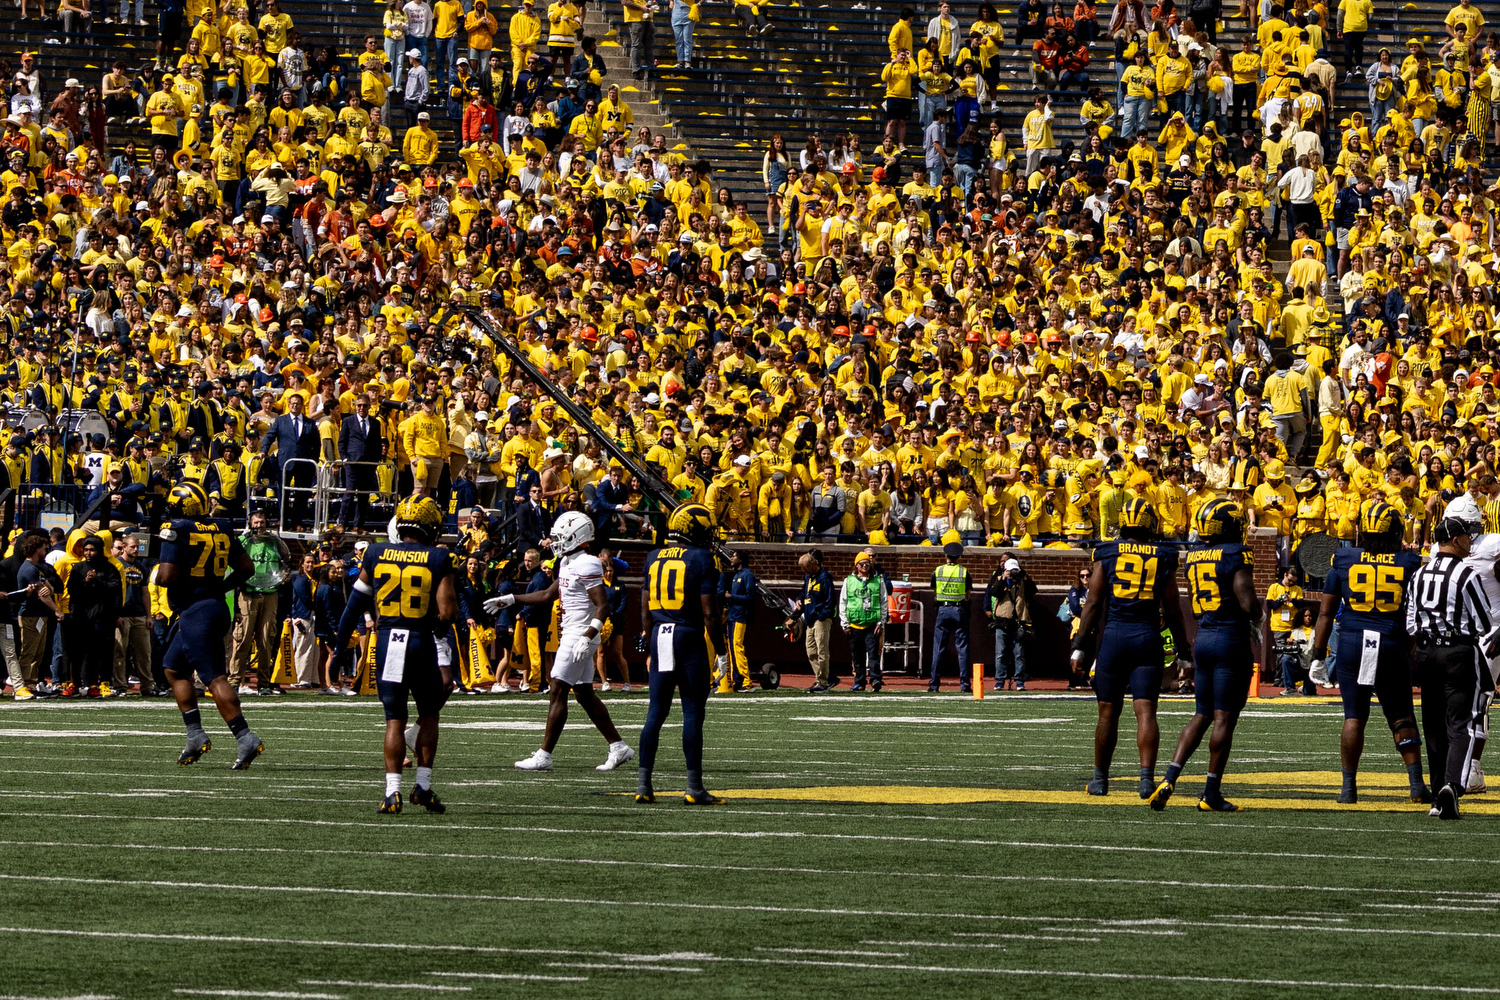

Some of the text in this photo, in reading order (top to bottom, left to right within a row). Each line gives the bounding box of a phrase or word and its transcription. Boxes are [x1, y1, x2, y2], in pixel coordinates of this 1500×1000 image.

[926, 78, 945, 86] 2023
[1302, 94, 1317, 107] 24
[284, 111, 288, 124] 1
[607, 111, 621, 122] M
[306, 150, 320, 160] M
[1377, 278, 1388, 289] M
[89, 458, 102, 467] M
[686, 486, 696, 494] M
[738, 480, 748, 488] M
[189, 532, 230, 576] 78
[656, 548, 688, 559] BERRY
[1118, 543, 1157, 554] BRANDT
[379, 548, 430, 564] JOHNSON
[1360, 552, 1395, 564] PIERCE
[1112, 554, 1158, 599] 91
[374, 563, 432, 618] 28
[648, 559, 686, 610] 10
[1187, 562, 1221, 614] 15
[1348, 564, 1404, 612] 95
[1418, 573, 1444, 609] U
[898, 592, 906, 604] G
[661, 626, 672, 634] M
[392, 633, 405, 642] M
[1365, 640, 1377, 648] M
[283, 633, 292, 677] MICHIGAN
[470, 637, 482, 679] MICHIGAN
